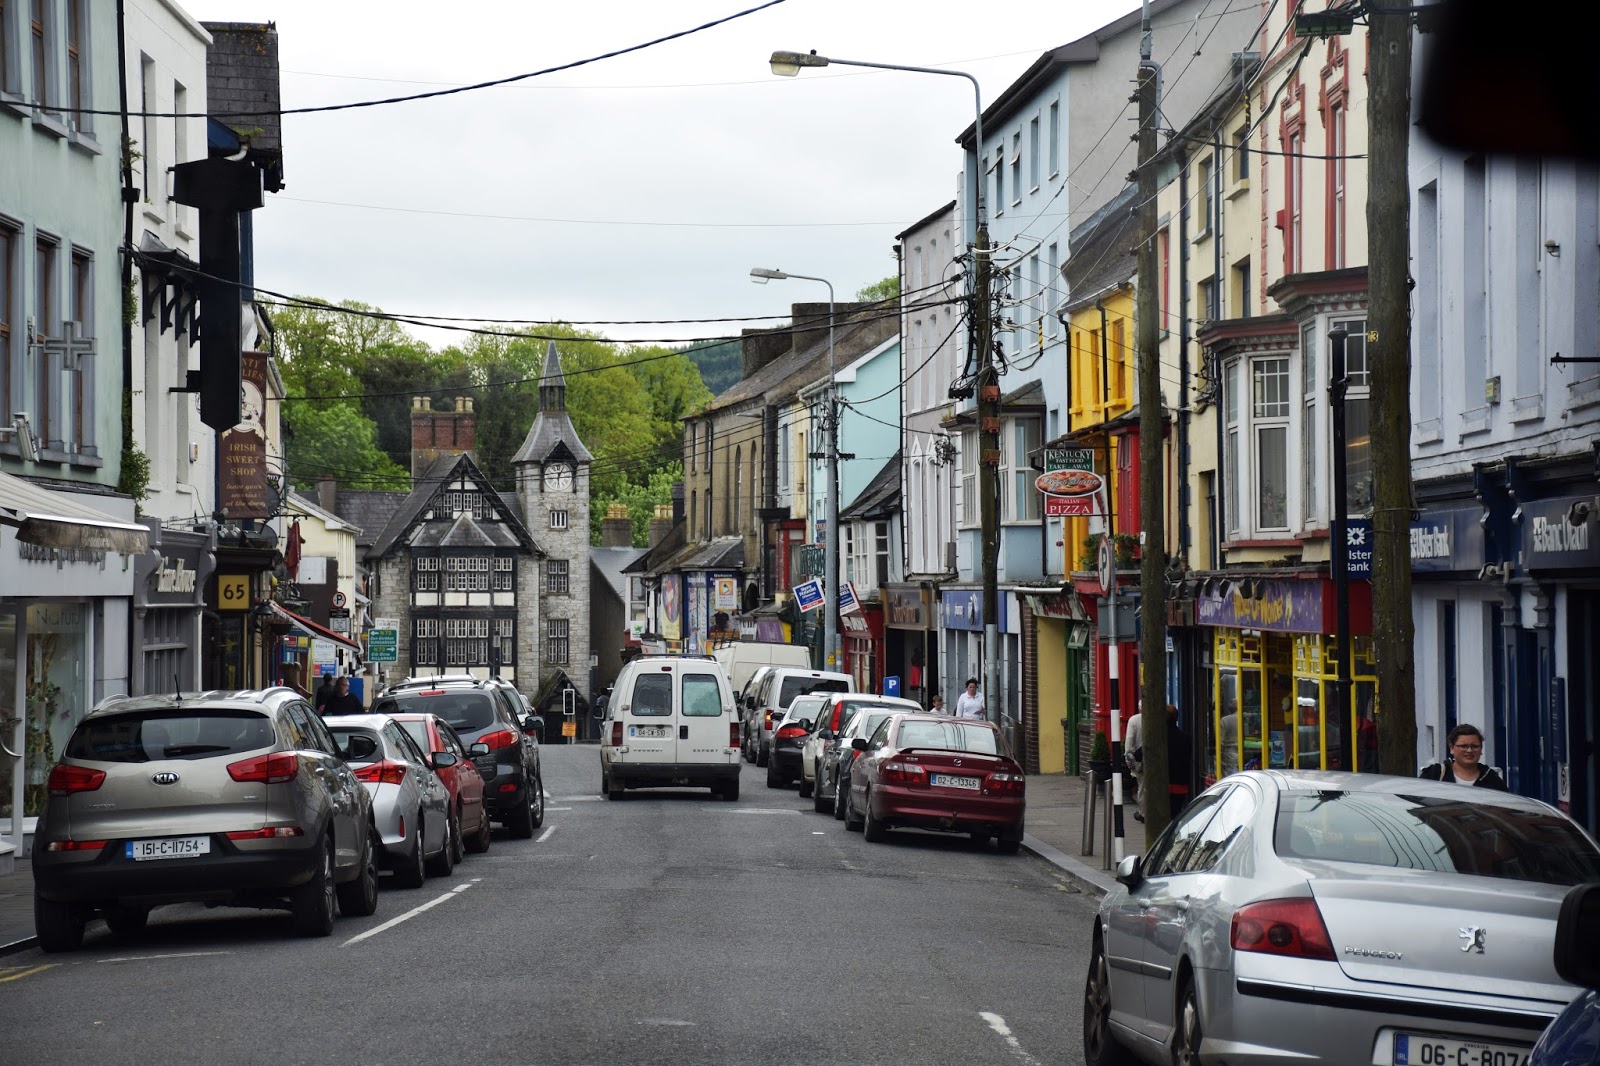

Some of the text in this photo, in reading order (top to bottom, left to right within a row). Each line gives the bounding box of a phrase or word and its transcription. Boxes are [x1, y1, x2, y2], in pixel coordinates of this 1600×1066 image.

[242, 358, 260, 368] NTY
[242, 369, 264, 380] LIES
[229, 443, 256, 452] IRISH
[226, 455, 259, 464] SWEET
[1048, 450, 1091, 460] KENTUCKY
[230, 468, 256, 476] SHOP
[1050, 505, 1090, 514] PIZZA
[1541, 517, 1563, 552] Banc
[1433, 525, 1450, 557] Bank
[1348, 550, 1372, 560] lster
[1101, 547, 1108, 585] P
[1347, 562, 1370, 571] ank
[223, 583, 245, 600] 65
[336, 594, 342, 605] P
[888, 679, 897, 689] P
[155, 773, 176, 783] KIA
[142, 840, 199, 856] 151-C-11754
[1345, 946, 1403, 960] PEUGEOT
